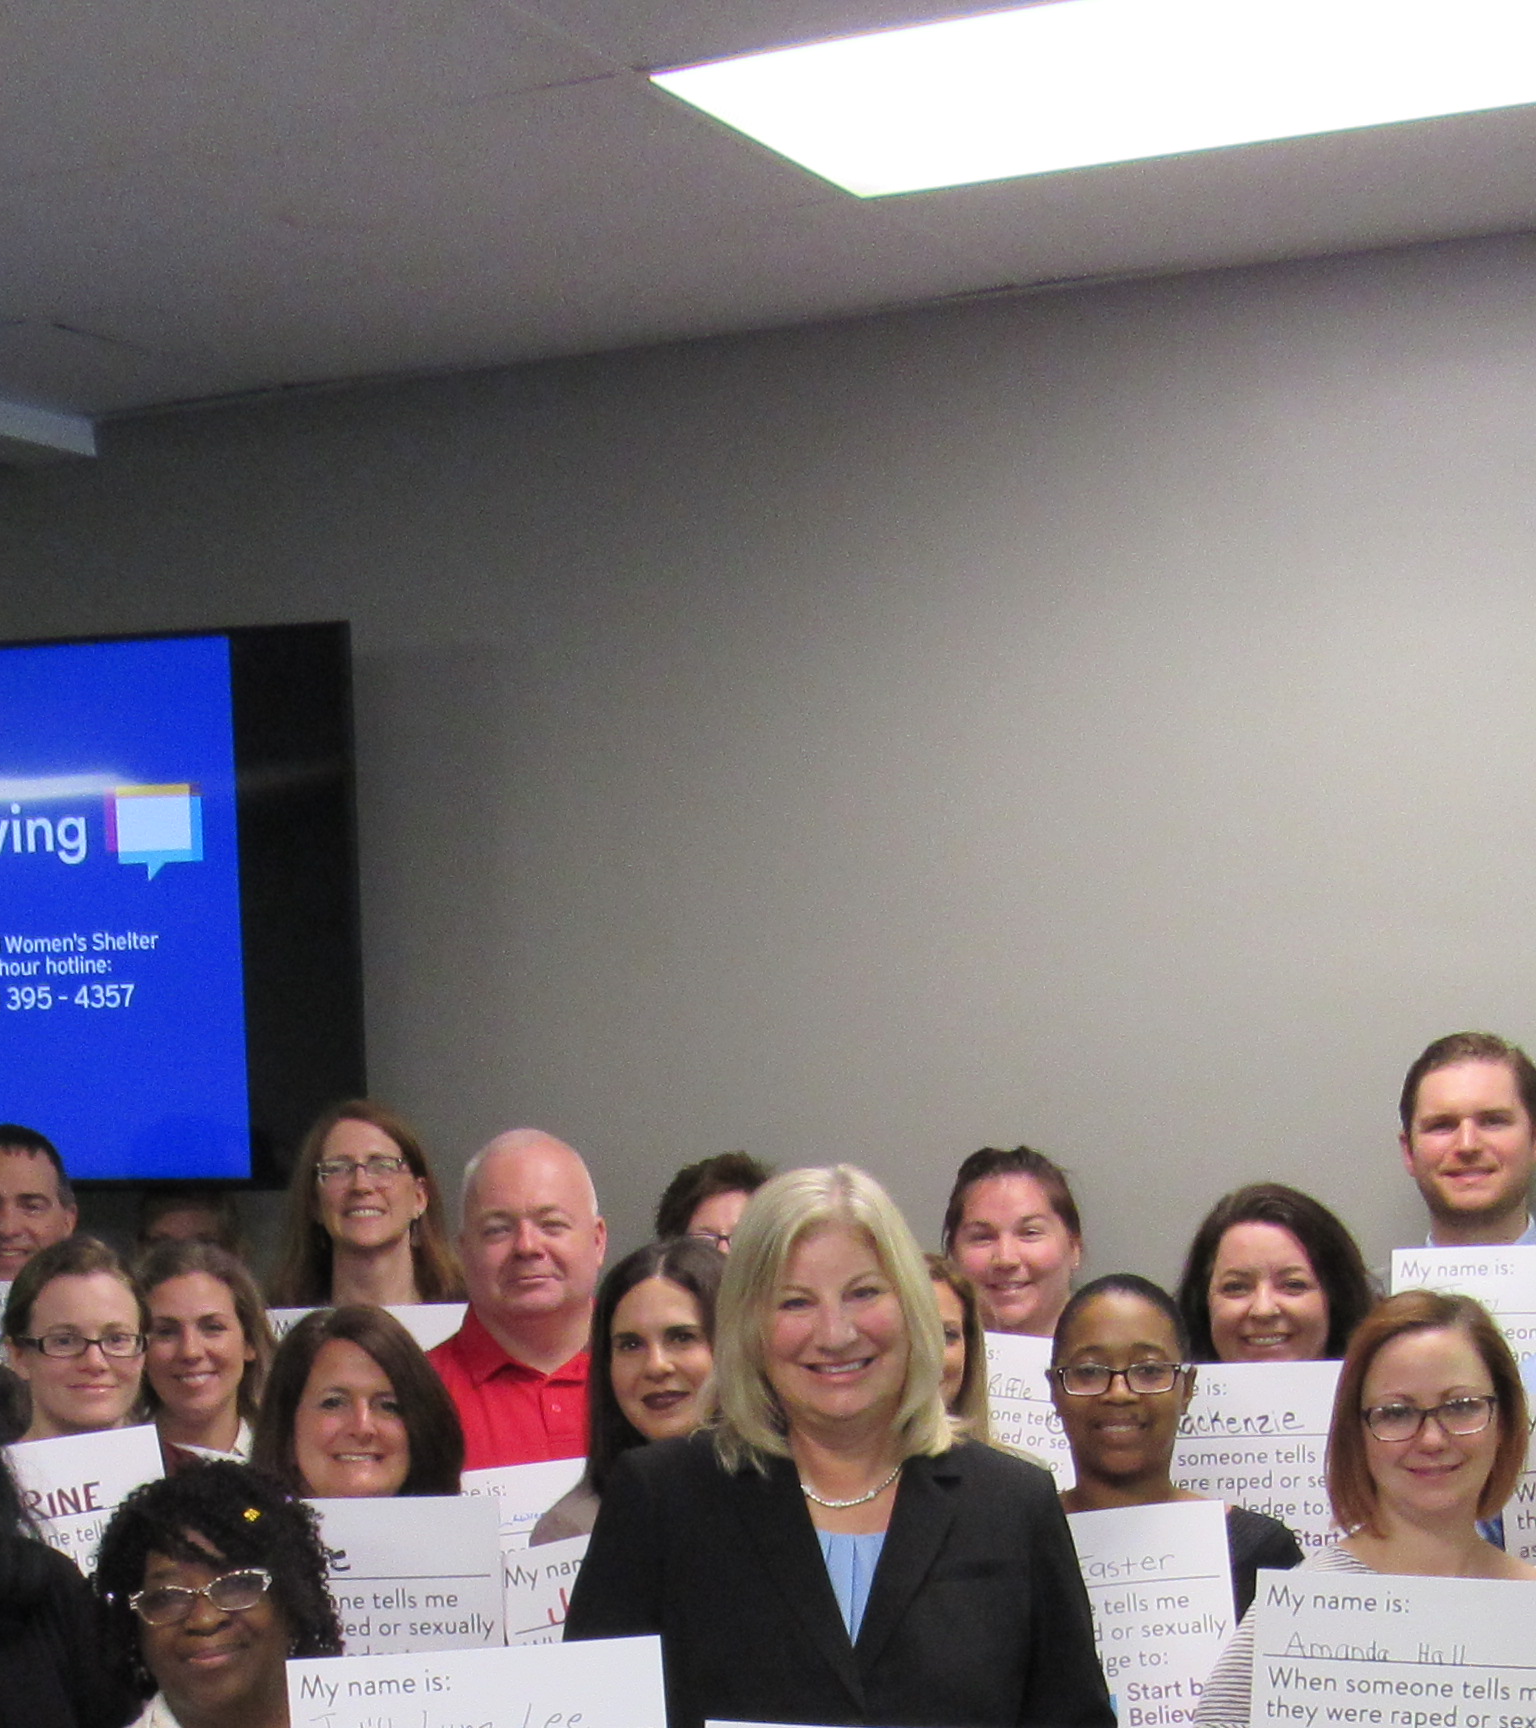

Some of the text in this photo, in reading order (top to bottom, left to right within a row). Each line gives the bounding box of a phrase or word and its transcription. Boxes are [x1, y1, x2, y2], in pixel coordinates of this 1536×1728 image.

[5, 933, 88, 954] Women's
[92, 931, 160, 951] Shelter
[46, 955, 112, 974] hotline:
[6, 986, 52, 1010] 395
[74, 983, 135, 1008] 4357
[1400, 1258, 1514, 1283] My name is:
[1178, 1446, 1316, 1467] someone tells
[1216, 1471, 1302, 1498] raped or
[22, 1482, 104, 1521] RINE
[1104, 1592, 1189, 1616] tells me
[1111, 1613, 1227, 1641] or sexually
[1127, 1681, 1182, 1702] Start
